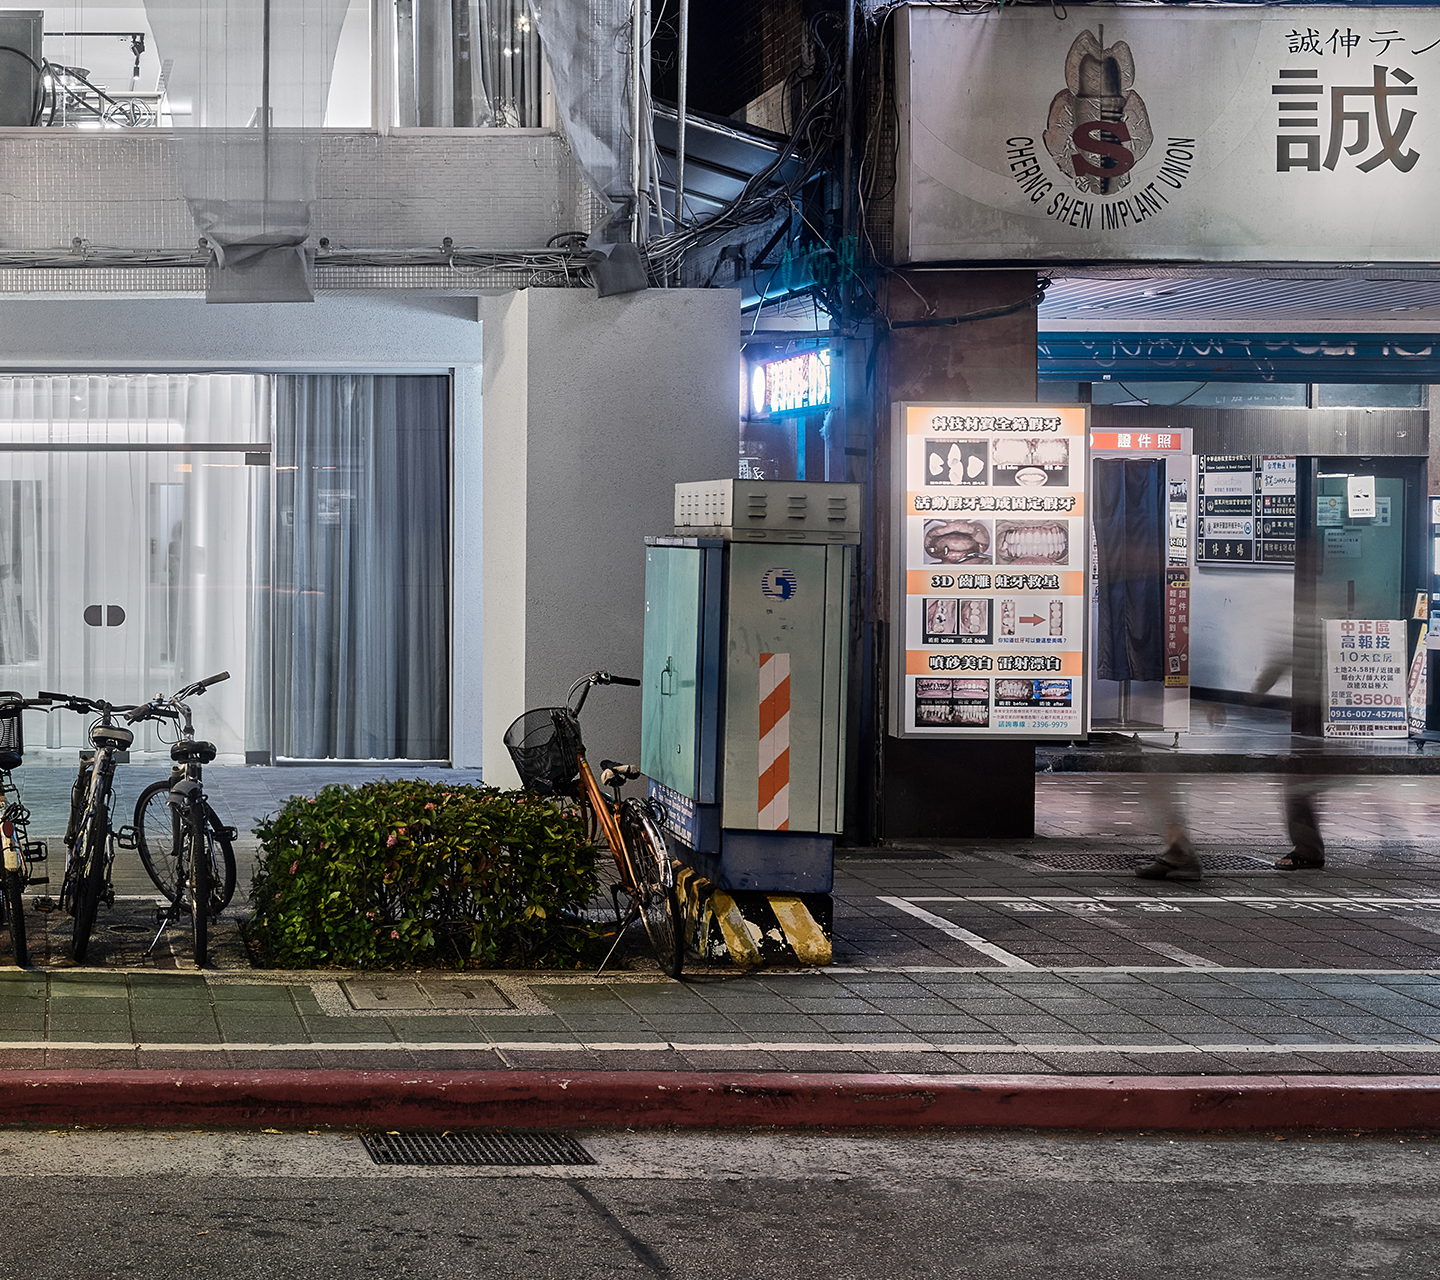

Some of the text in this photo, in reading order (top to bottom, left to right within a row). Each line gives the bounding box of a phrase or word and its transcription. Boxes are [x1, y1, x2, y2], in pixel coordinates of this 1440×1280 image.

[1271, 63, 1421, 175] 誠
[1006, 135, 1196, 230] CHERNG SHEN IMPLANT UNION
[1117, 433, 1171, 448] 證件照
[1200, 478, 1204, 491] 4
[914, 496, 1076, 512] 活動假牙變成固定假牙
[1200, 499, 1204, 513] 3
[1256, 499, 1260, 513] 9
[1200, 521, 1204, 534] 2
[1257, 521, 1260, 535] 8
[1212, 543, 1244, 557] 停車場
[1257, 544, 1260, 557] 7
[931, 573, 1060, 590] 3D 齒雕 蛀牙救星
[1178, 589, 1186, 623] 證件照
[1340, 621, 1391, 635] 中正區
[1340, 635, 1391, 649] 高報投
[929, 655, 1062, 672] 噴砂美白 雷射漂白
[1340, 651, 1392, 662] 10大套房
[1353, 694, 1402, 705] 3580萬
